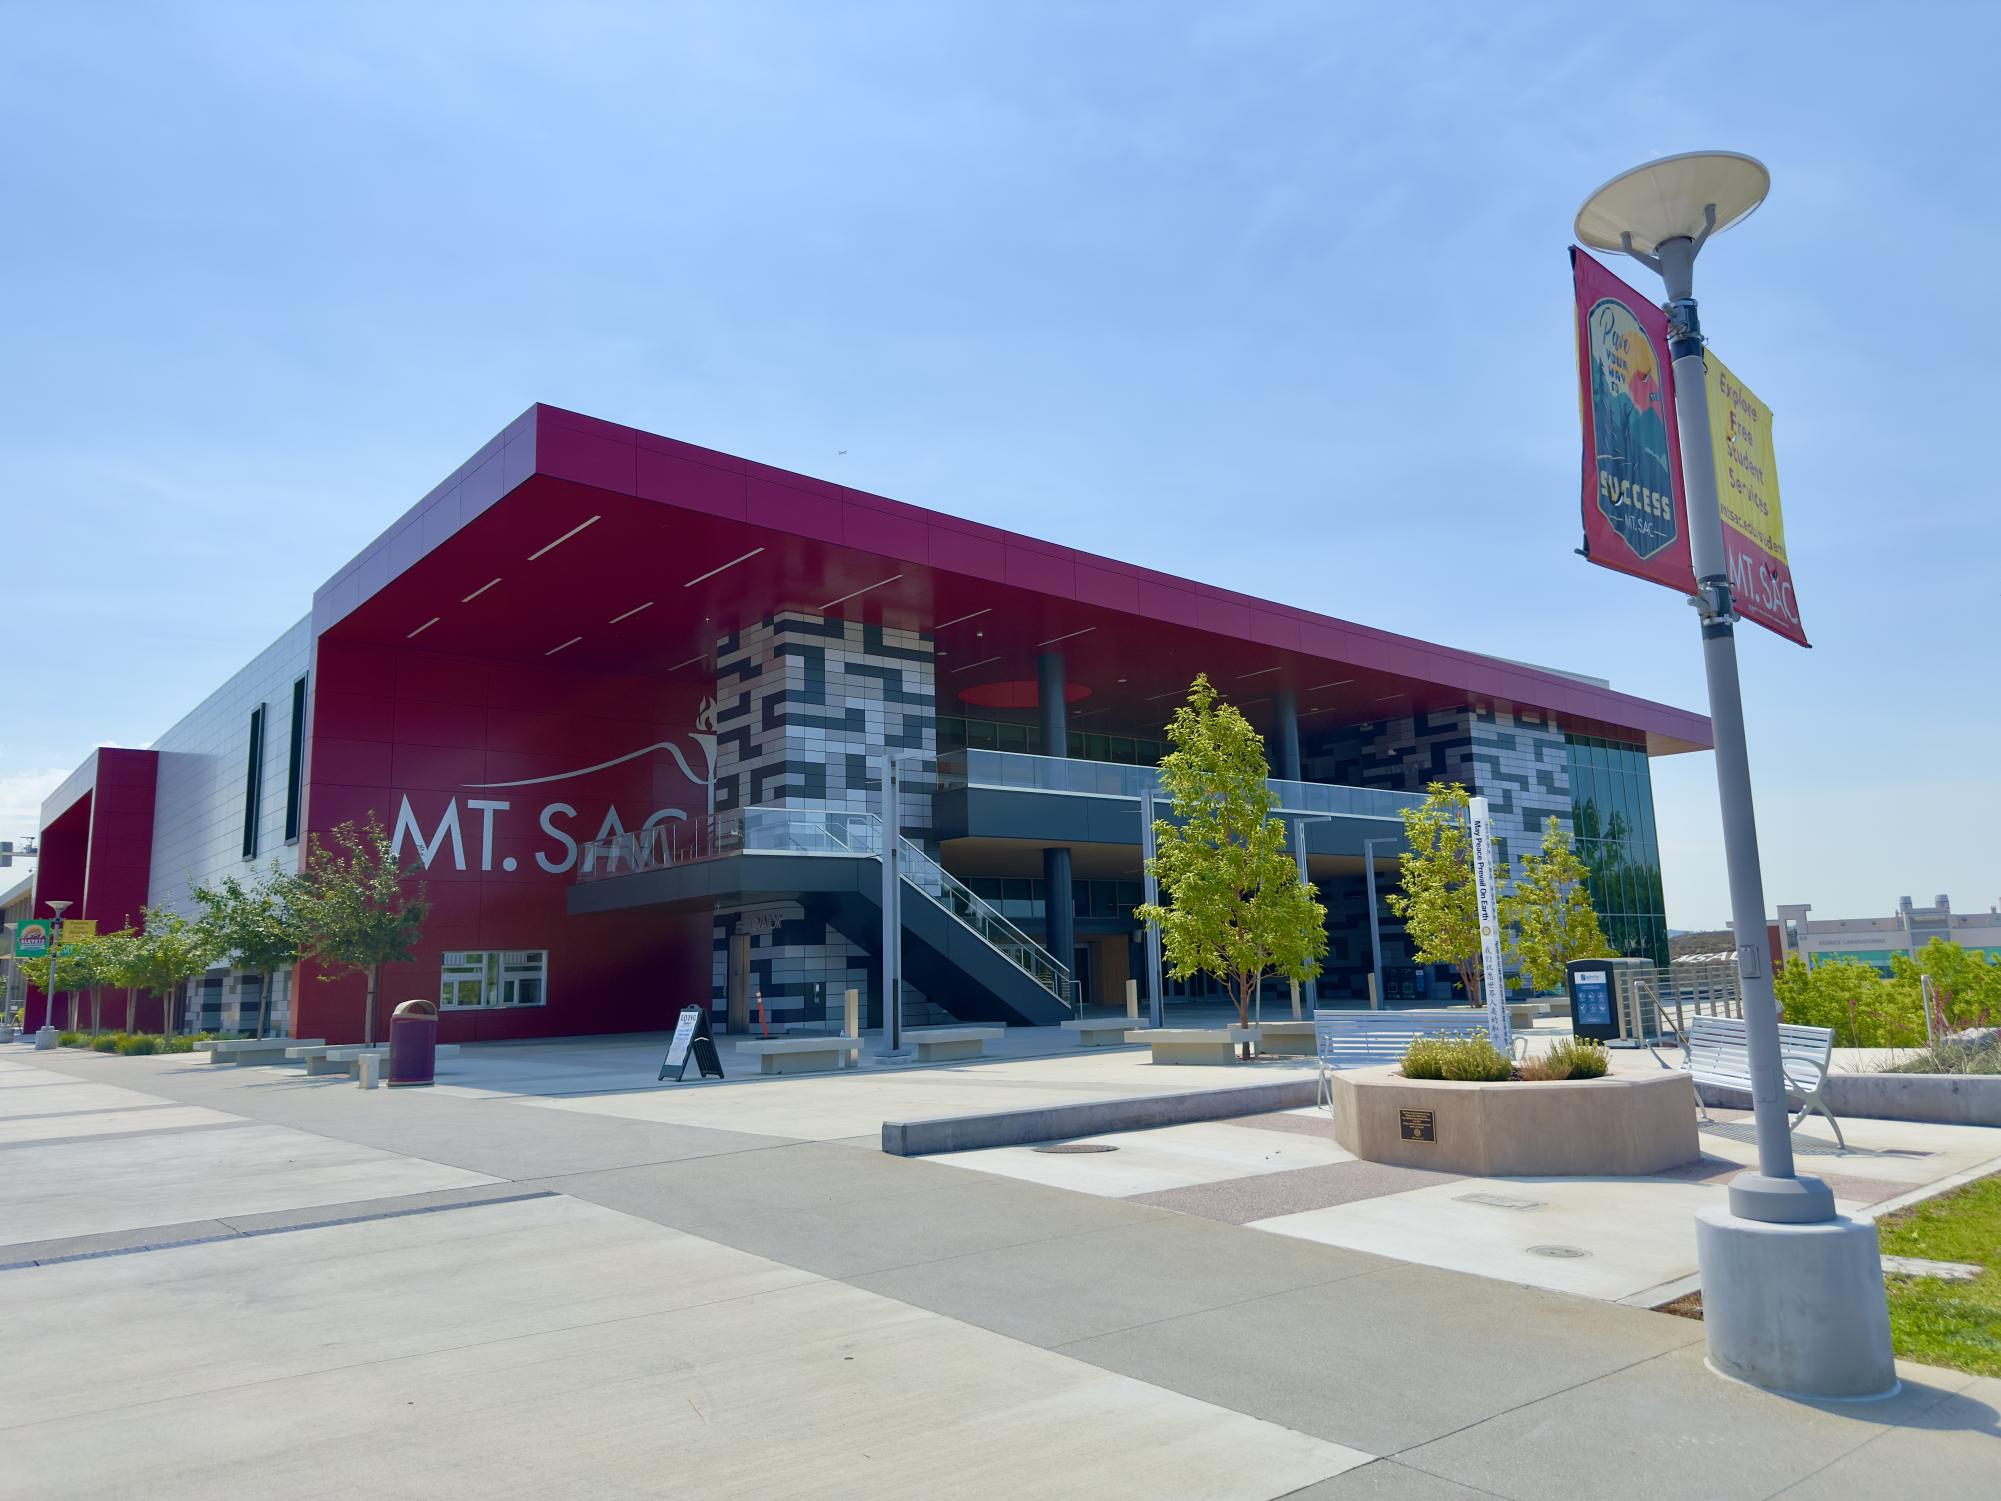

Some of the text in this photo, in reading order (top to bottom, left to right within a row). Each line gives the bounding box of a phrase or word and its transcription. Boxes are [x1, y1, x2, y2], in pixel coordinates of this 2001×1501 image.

[1600, 307, 1630, 355] Pave
[1606, 347, 1628, 372] YOUR
[1608, 364, 1626, 384] WAY
[1611, 380, 1619, 394] TO
[1719, 372, 1758, 423] Explore
[1729, 409, 1753, 446] Free
[1727, 443, 1764, 485] Student
[1600, 470, 1671, 520] SUCCESS
[1728, 467, 1769, 516] Services
[1624, 513, 1655, 538] MT. SAC
[1728, 543, 1799, 624] MT. SAC
[390, 792, 688, 874] MT. SAC
[1475, 837, 1483, 861] Peace
[1477, 861, 1486, 887] Prevail
[1480, 887, 1488, 899] On
[1480, 900, 1489, 921] Earth
